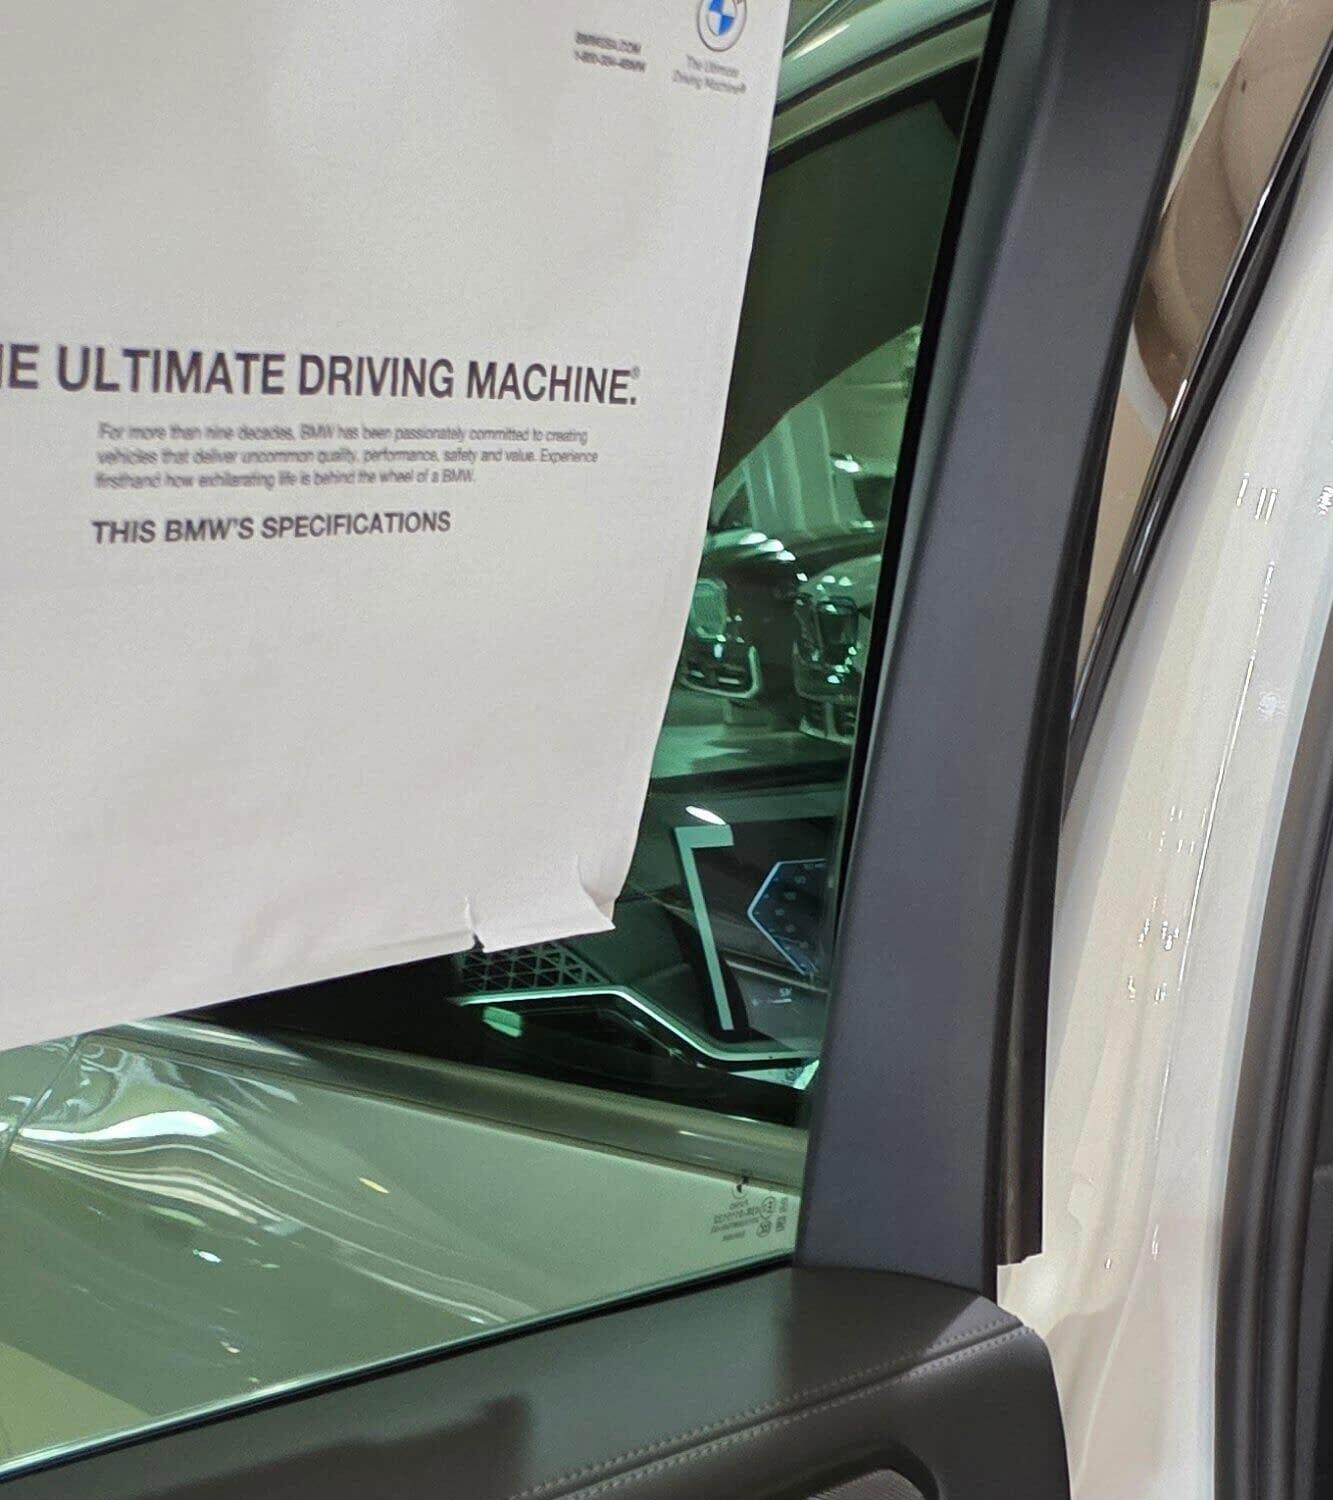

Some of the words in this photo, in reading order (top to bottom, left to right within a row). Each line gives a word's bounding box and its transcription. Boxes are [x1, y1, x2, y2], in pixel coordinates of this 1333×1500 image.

[0, 344, 39, 389] E
[57, 345, 286, 395] ULTIMATE
[299, 354, 455, 398] DRIVING
[128, 425, 167, 440] more
[168, 423, 201, 440] than
[299, 423, 335, 439] BMW
[336, 424, 358, 439] has
[361, 423, 392, 439] been
[394, 425, 467, 443] passionately
[468, 427, 529, 442] committed
[532, 428, 544, 442] to
[545, 428, 589, 446] creating
[97, 448, 159, 465] vehicles
[161, 449, 190, 464] that
[192, 448, 238, 464] deliver
[240, 450, 315, 464] uncommon
[363, 448, 440, 464] performance,
[443, 447, 477, 465] safety
[480, 449, 502, 463] and
[540, 449, 599, 465] Experience
[163, 472, 195, 488] how
[278, 470, 298, 486] life
[300, 470, 312, 486] is
[313, 470, 356, 485] behind
[358, 470, 376, 483] the
[379, 469, 414, 484] wheel
[416, 469, 428, 483] of
[430, 471, 440, 484] a
[441, 468, 475, 484] BMW.
[91, 519, 156, 544] THIS
[164, 516, 255, 543] BMW'S
[260, 510, 452, 540] SPECIFICATIONS
